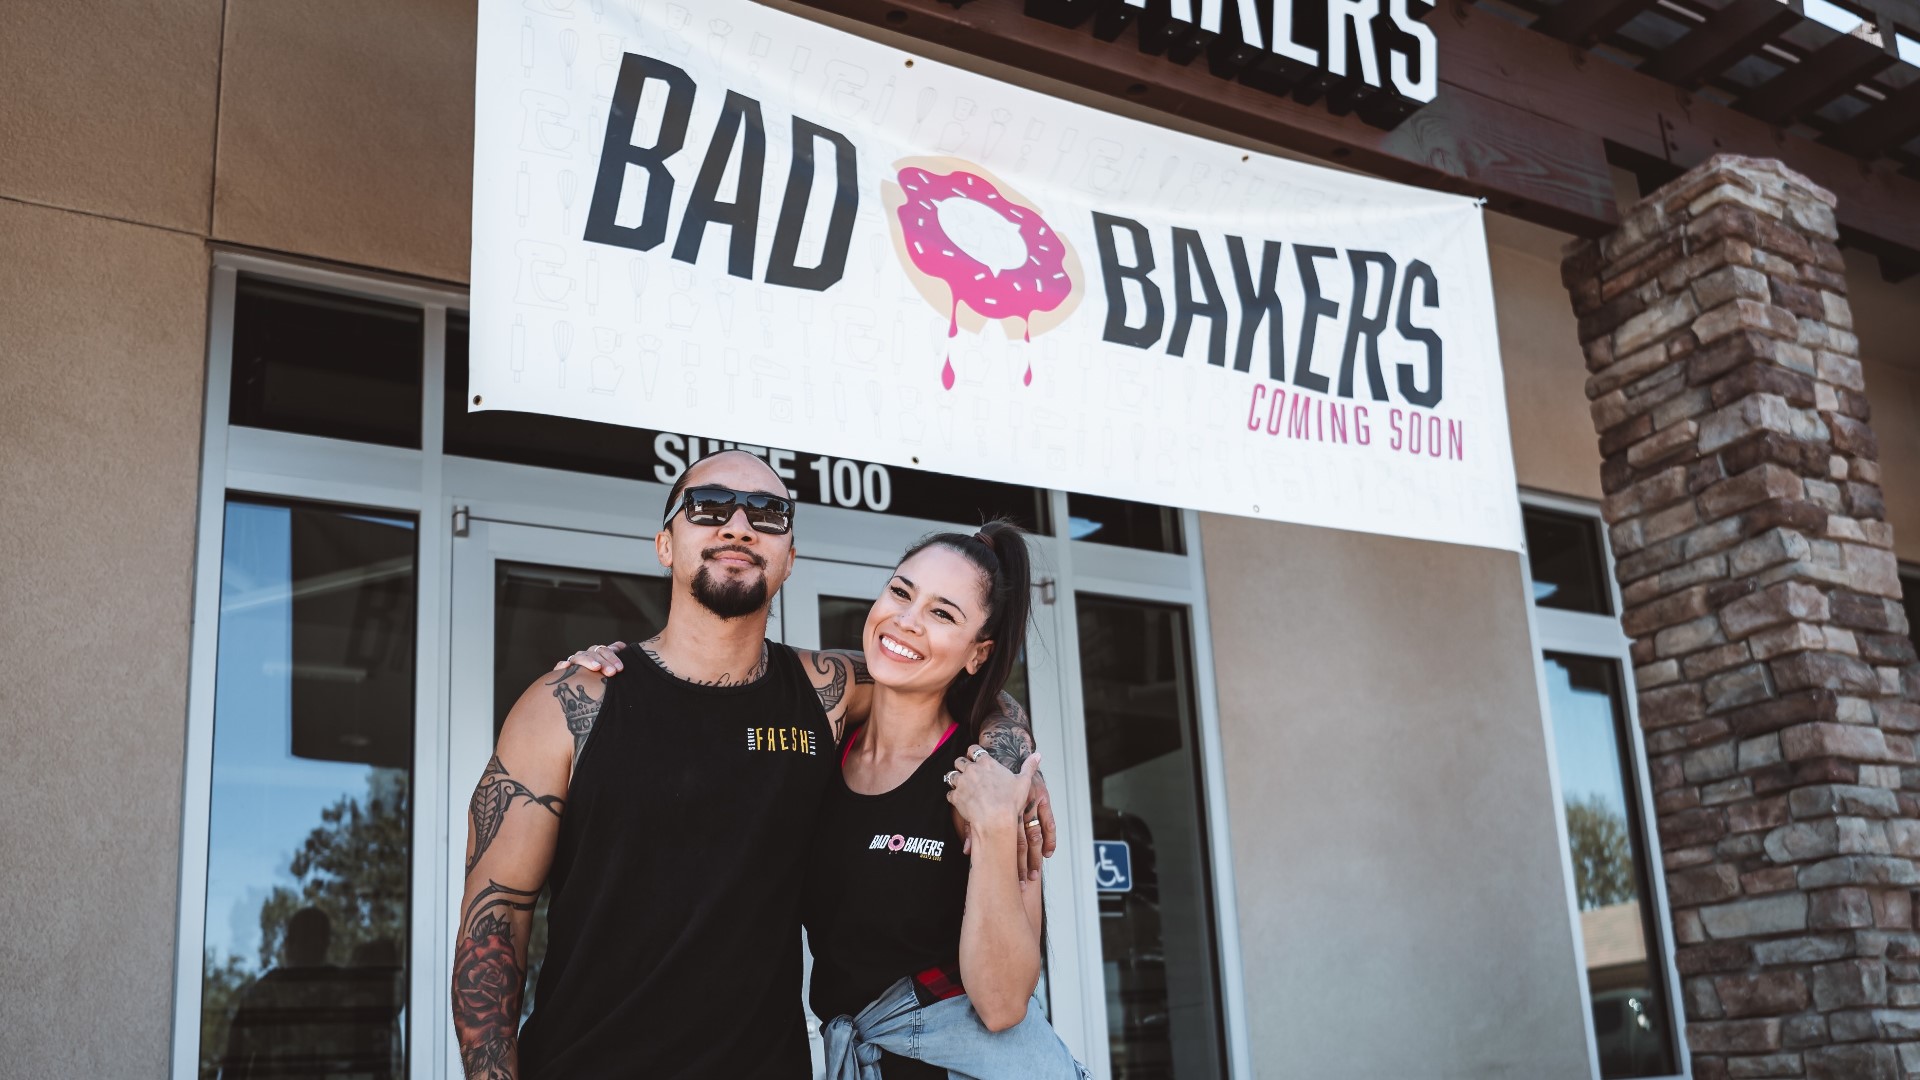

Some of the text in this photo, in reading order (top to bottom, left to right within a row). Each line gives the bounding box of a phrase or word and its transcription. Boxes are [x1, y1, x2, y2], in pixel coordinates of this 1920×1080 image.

[583, 51, 860, 292] BAD
[1091, 210, 1443, 409] BAKERS
[1247, 383, 1464, 462] COMING SOON
[810, 456, 892, 512] 100
[756, 726, 809, 754] FRESH
[868, 834, 945, 857] BAD BAKERS
